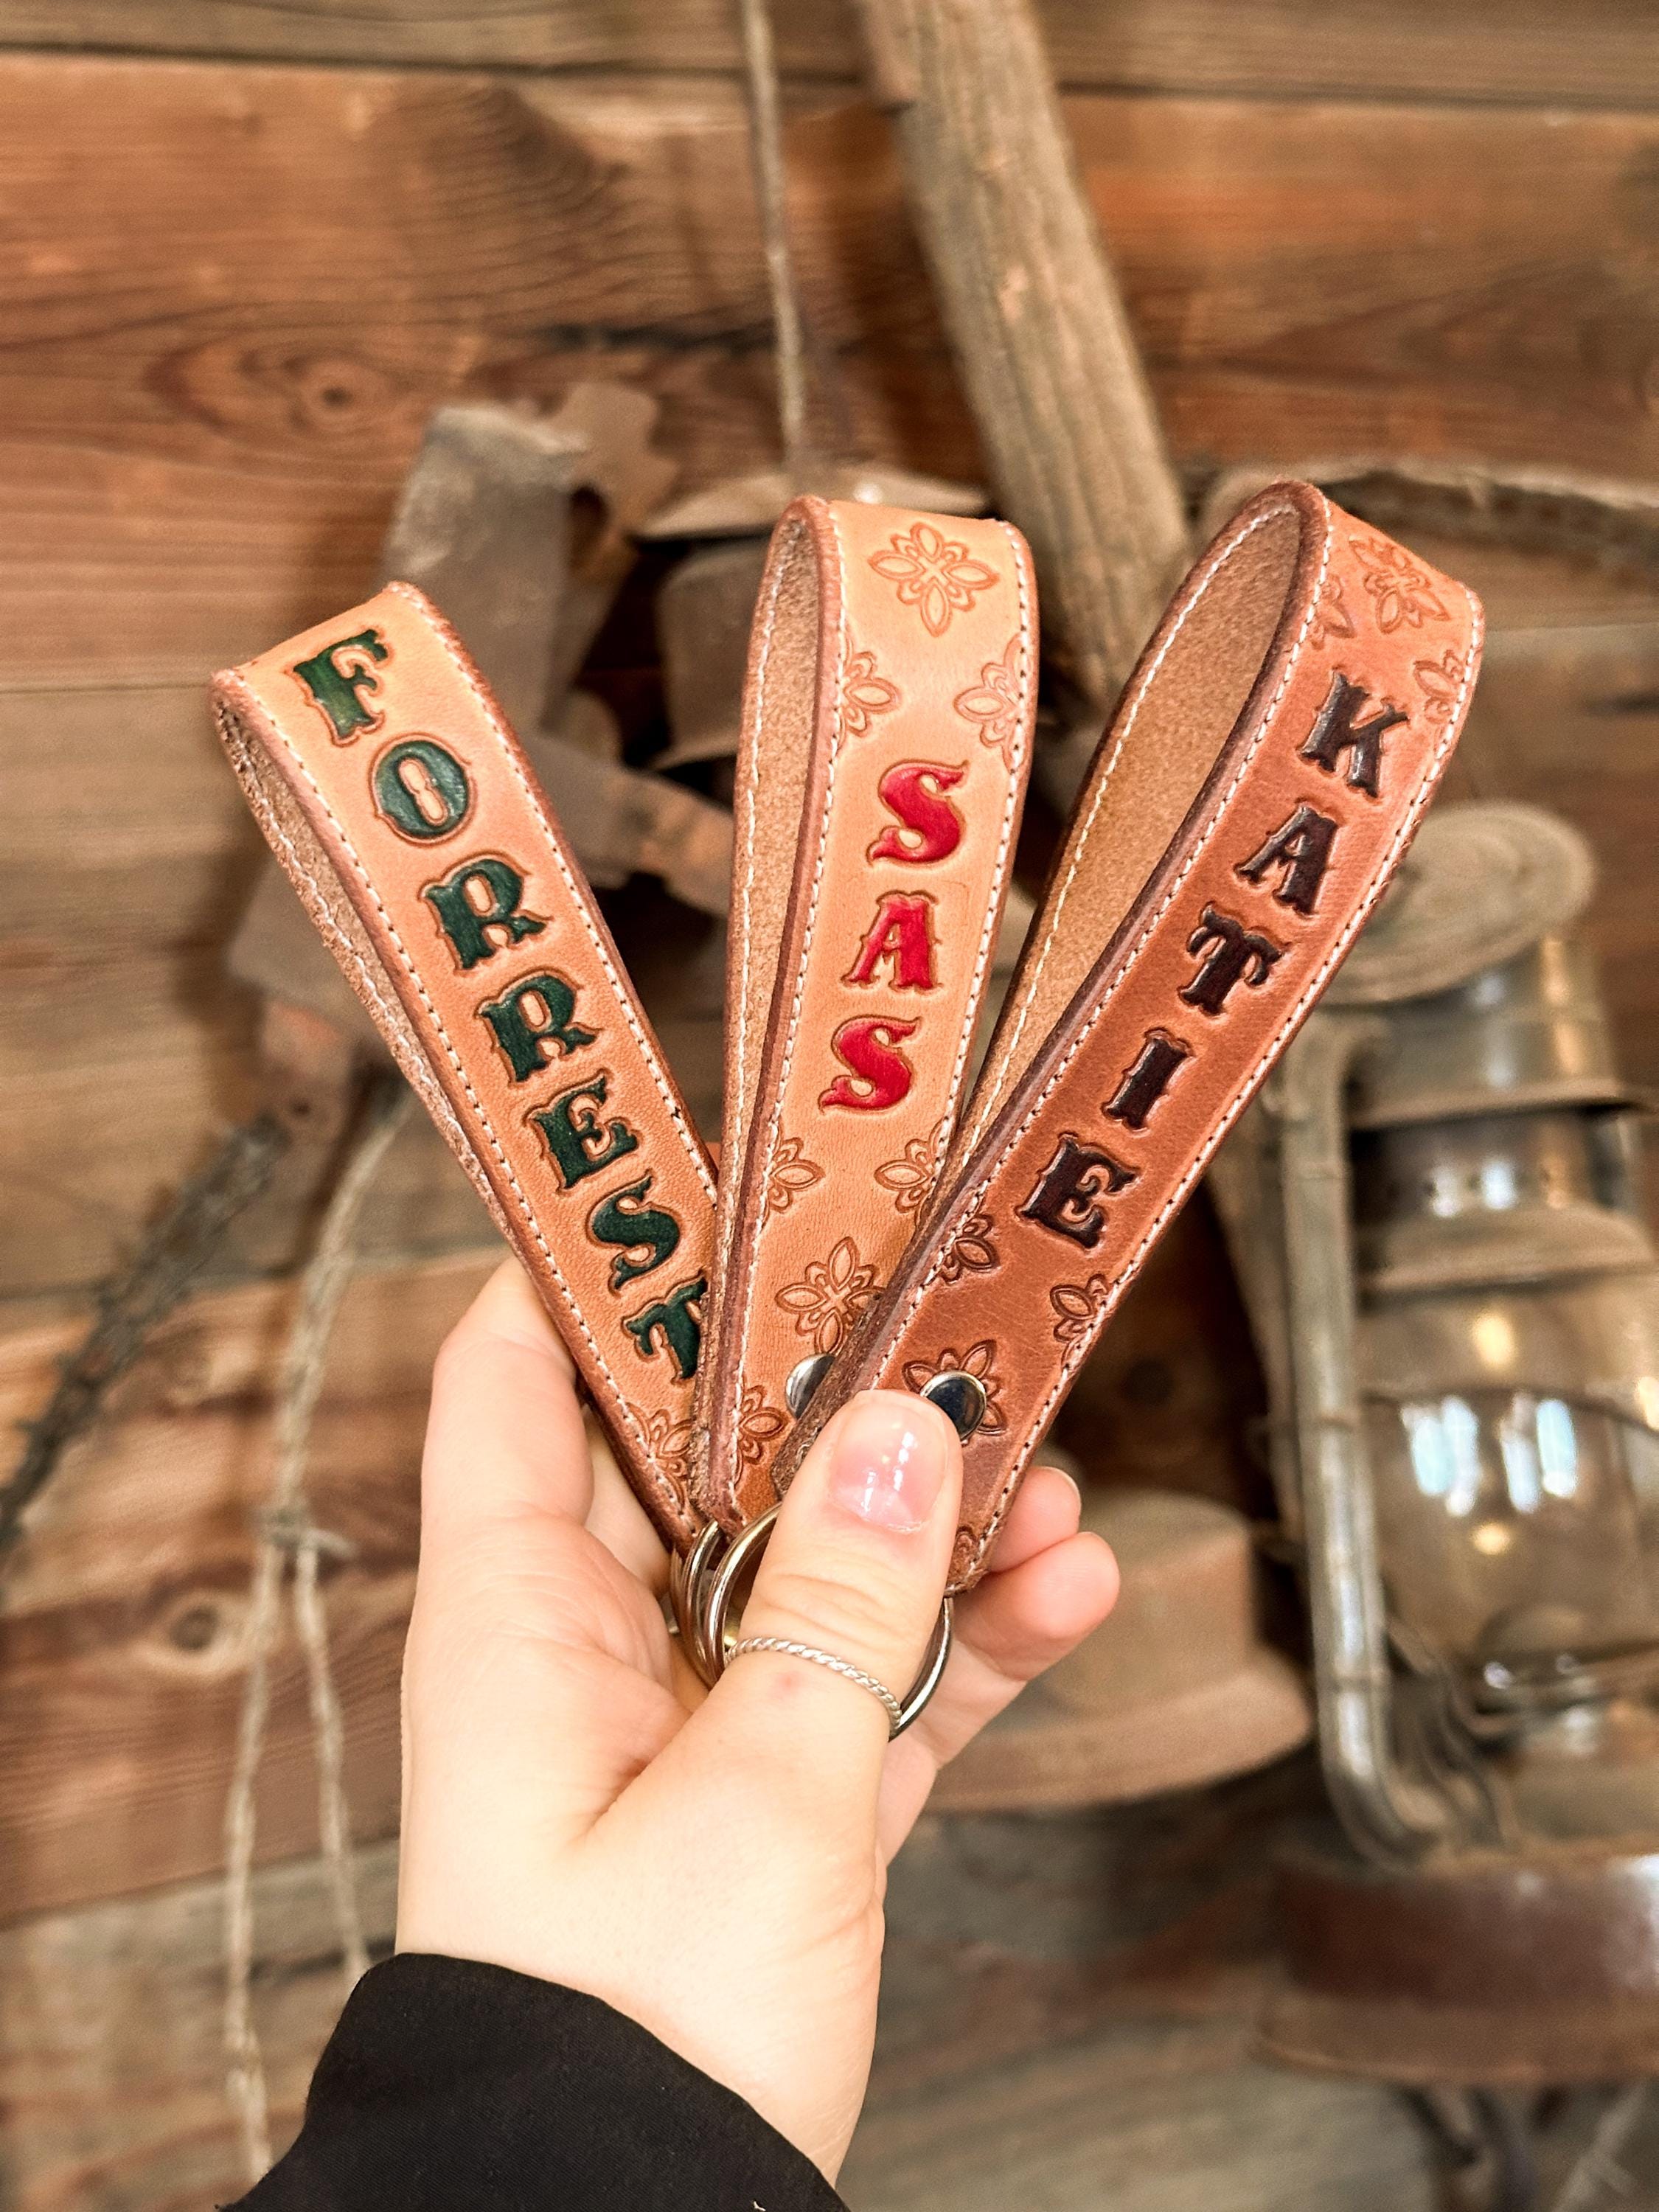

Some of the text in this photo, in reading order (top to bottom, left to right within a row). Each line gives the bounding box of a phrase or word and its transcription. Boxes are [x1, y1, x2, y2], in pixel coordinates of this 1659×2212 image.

[294, 627, 709, 1382] FORREST
[820, 759, 967, 1112] SAS
[1017, 668, 1408, 1248] KATIE
